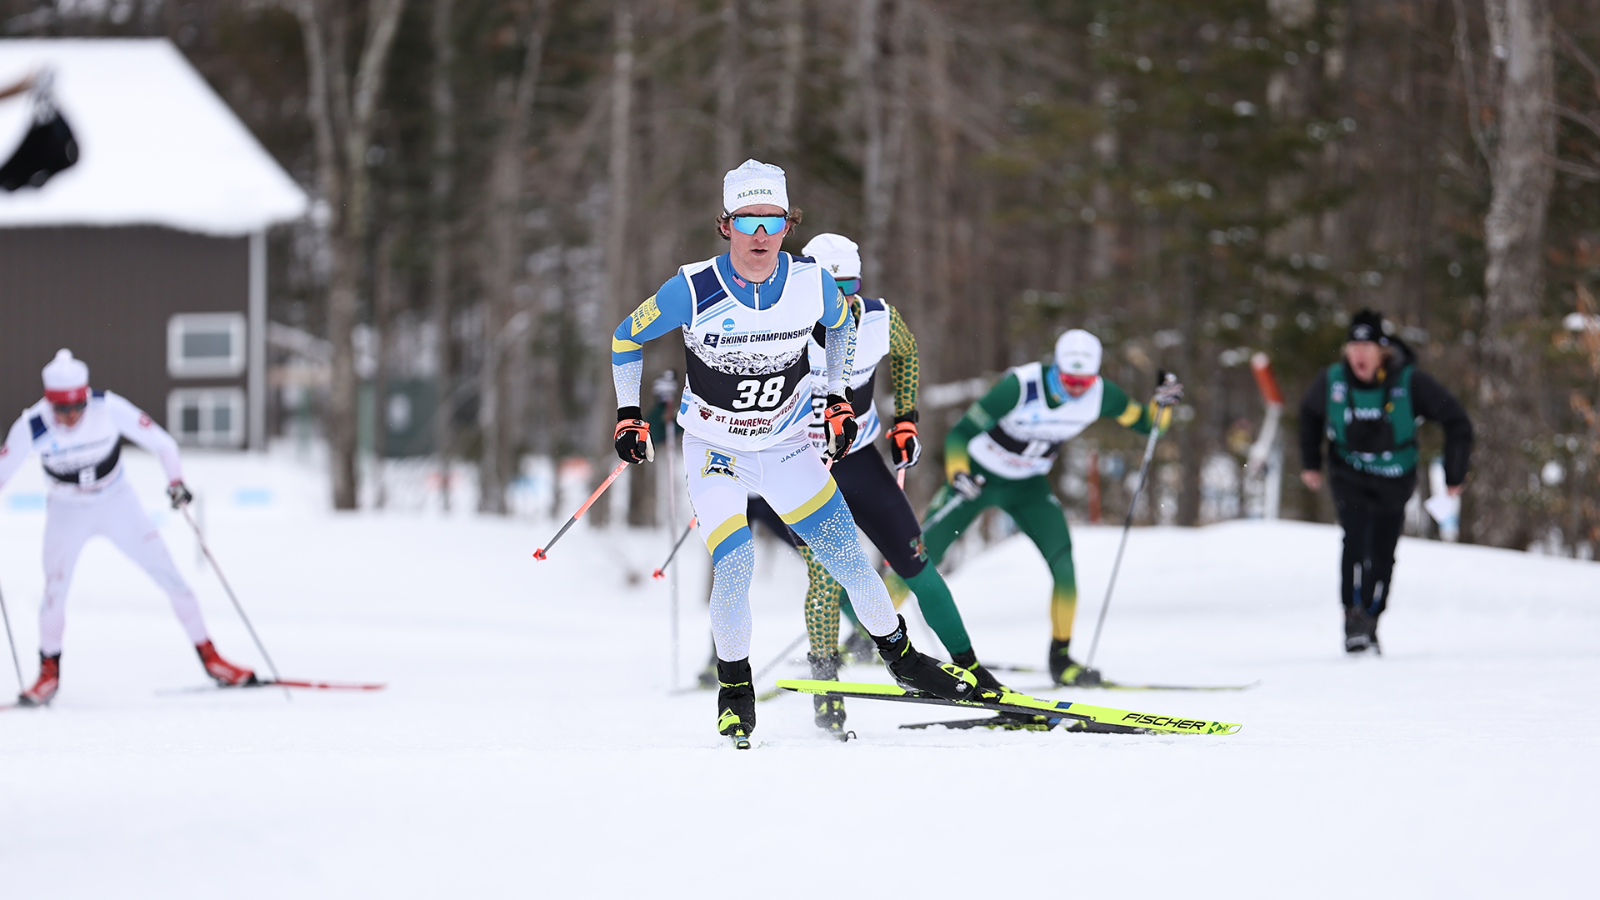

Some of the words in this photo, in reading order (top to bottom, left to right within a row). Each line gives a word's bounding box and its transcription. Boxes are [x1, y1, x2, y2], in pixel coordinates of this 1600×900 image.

[737, 189, 772, 199] ALASKA
[720, 335, 748, 345] SKIING
[750, 326, 812, 343] CHAMPIONSHIPS
[731, 375, 785, 410] 38
[715, 415, 728, 424] ST.
[729, 417, 772, 427] LAWRENCE
[728, 426, 748, 435] LAKE
[1121, 712, 1207, 731] FISCHER
